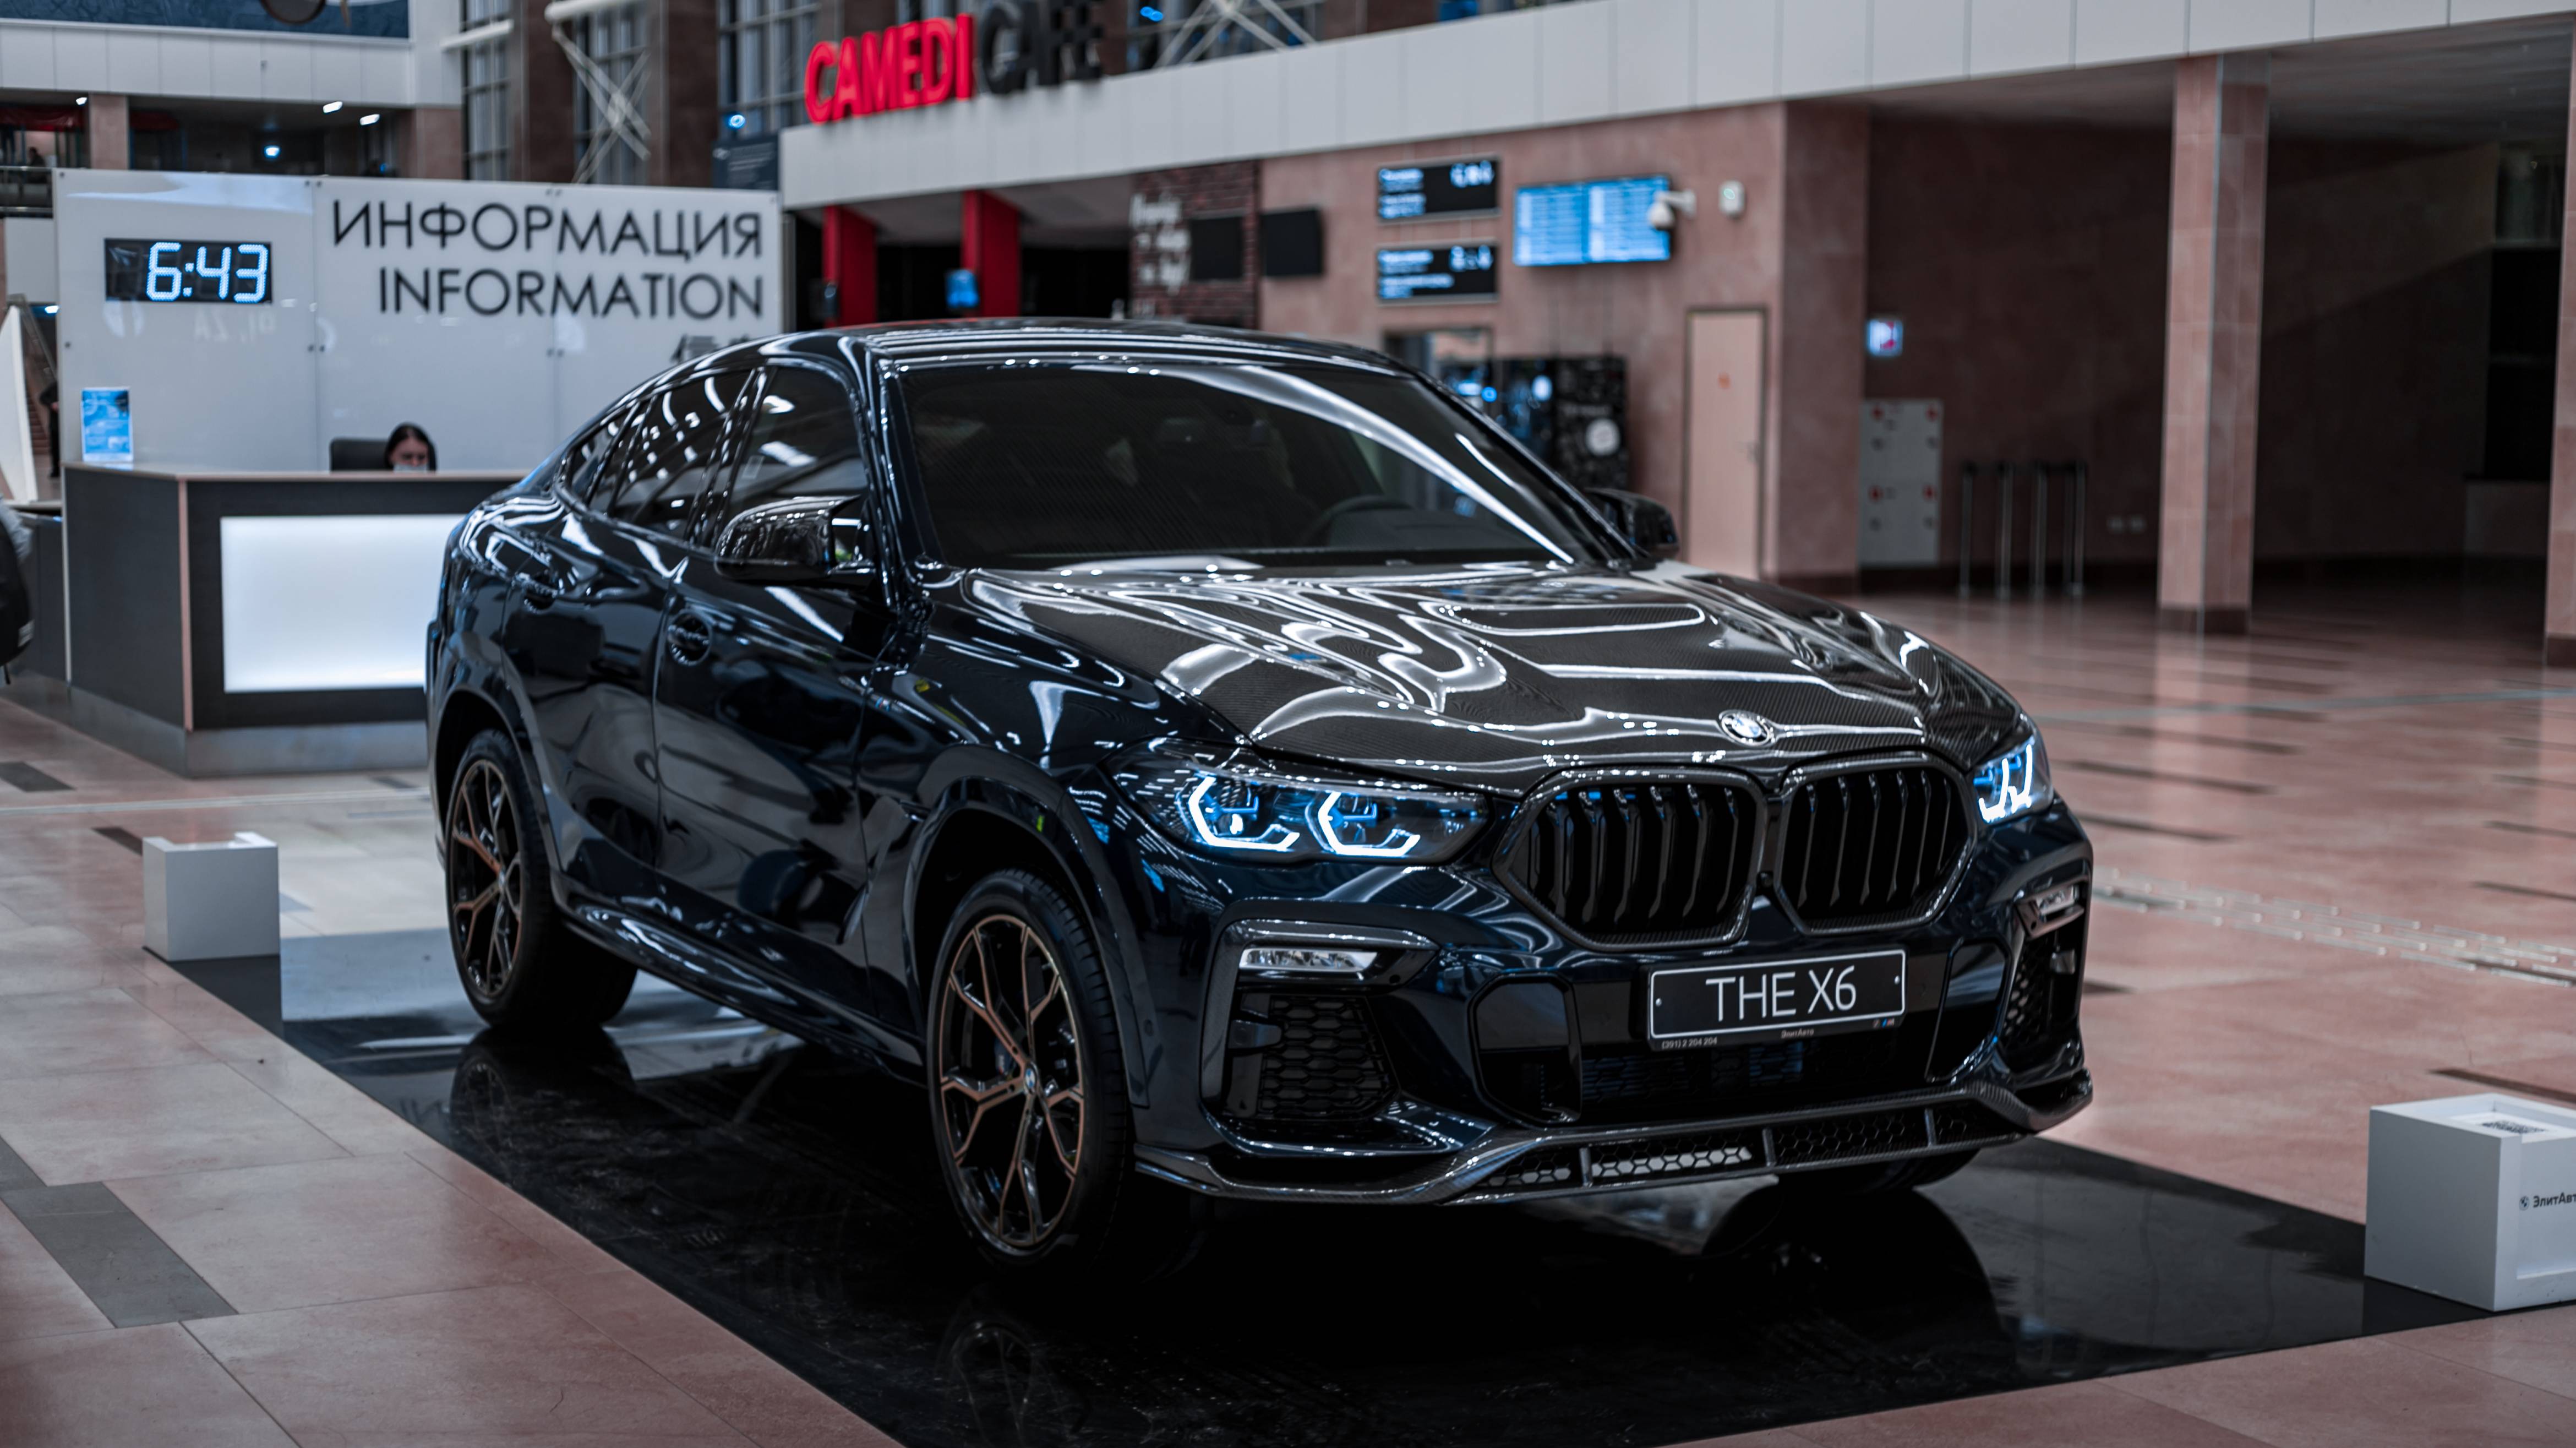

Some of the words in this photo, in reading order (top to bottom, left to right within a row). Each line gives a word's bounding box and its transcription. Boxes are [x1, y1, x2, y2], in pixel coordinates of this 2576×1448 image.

[804, 12, 975, 125] CAMEDI
[332, 198, 762, 262] ИНФОРМАЦИЯ
[146, 242, 269, 303] 6:43
[379, 266, 763, 321] INFORMATION
[1705, 971, 1796, 1022] THE
[1807, 965, 1857, 1014] X6
[1661, 1039, 1682, 1050] (391)
[1682, 1039, 1688, 1048] 2
[1689, 1038, 1702, 1047] 204
[1704, 1037, 1717, 1046] 204
